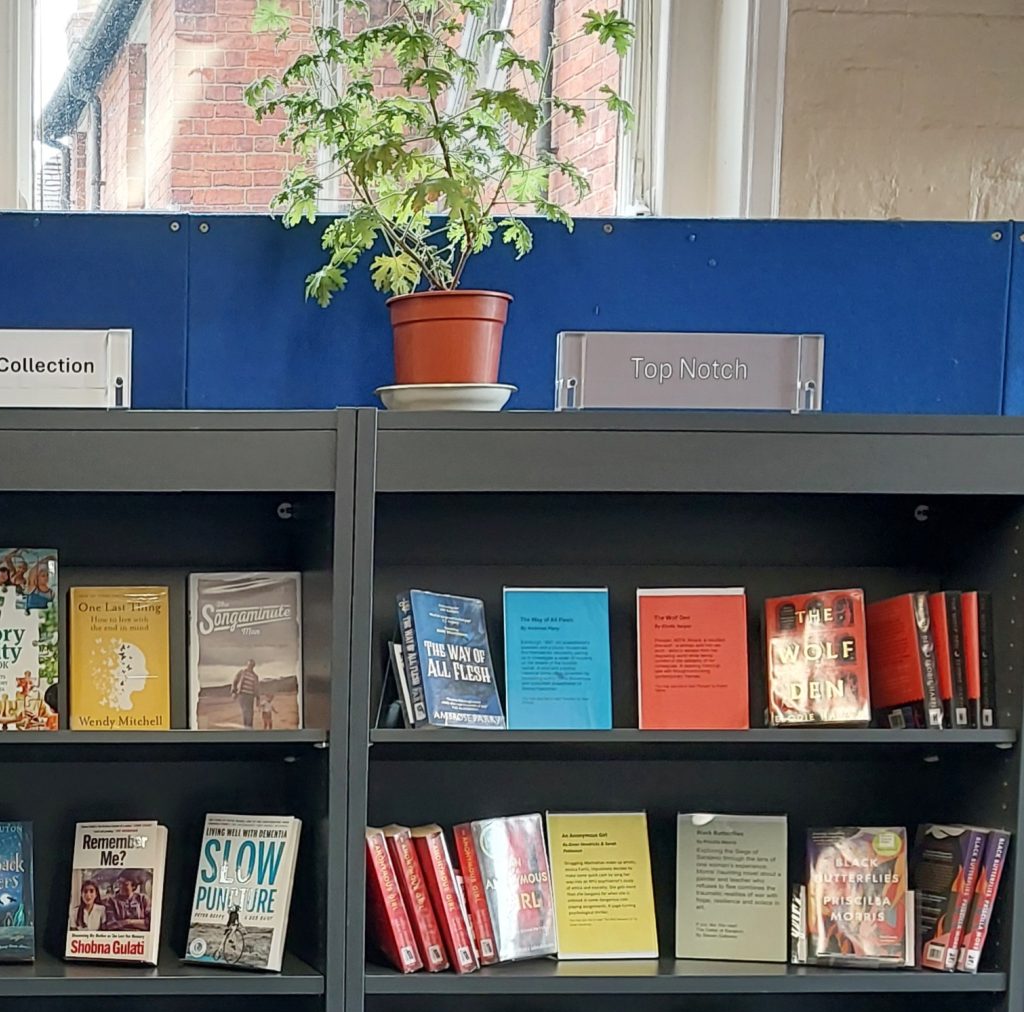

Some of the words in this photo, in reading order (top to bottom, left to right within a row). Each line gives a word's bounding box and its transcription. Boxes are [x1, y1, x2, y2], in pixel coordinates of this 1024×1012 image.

[631, 357, 672, 384] Top
[679, 358, 748, 379] Notch
[78, 602, 102, 612] One
[795, 608, 833, 624] THE
[424, 640, 445, 658] THE
[448, 644, 471, 662] WAY
[473, 648, 485, 663] OF
[778, 641, 854, 662] WOLF
[427, 660, 451, 678] ALL
[453, 662, 491, 683] FLESH
[79, 716, 115, 729] Wendy
[118, 716, 162, 726] Mitchell
[206, 827, 225, 837] LIVING
[227, 828, 241, 837] WELL
[243, 829, 257, 837] WITH
[259, 829, 287, 838] DEMENTIA
[83, 834, 148, 849] Remember
[100, 851, 126, 866] Me?
[201, 839, 285, 885] SLOW
[835, 858, 878, 868] BLACK
[830, 910, 885, 922] MORRIS
[70, 940, 110, 954] Shobna
[113, 940, 144, 954] Gulati
